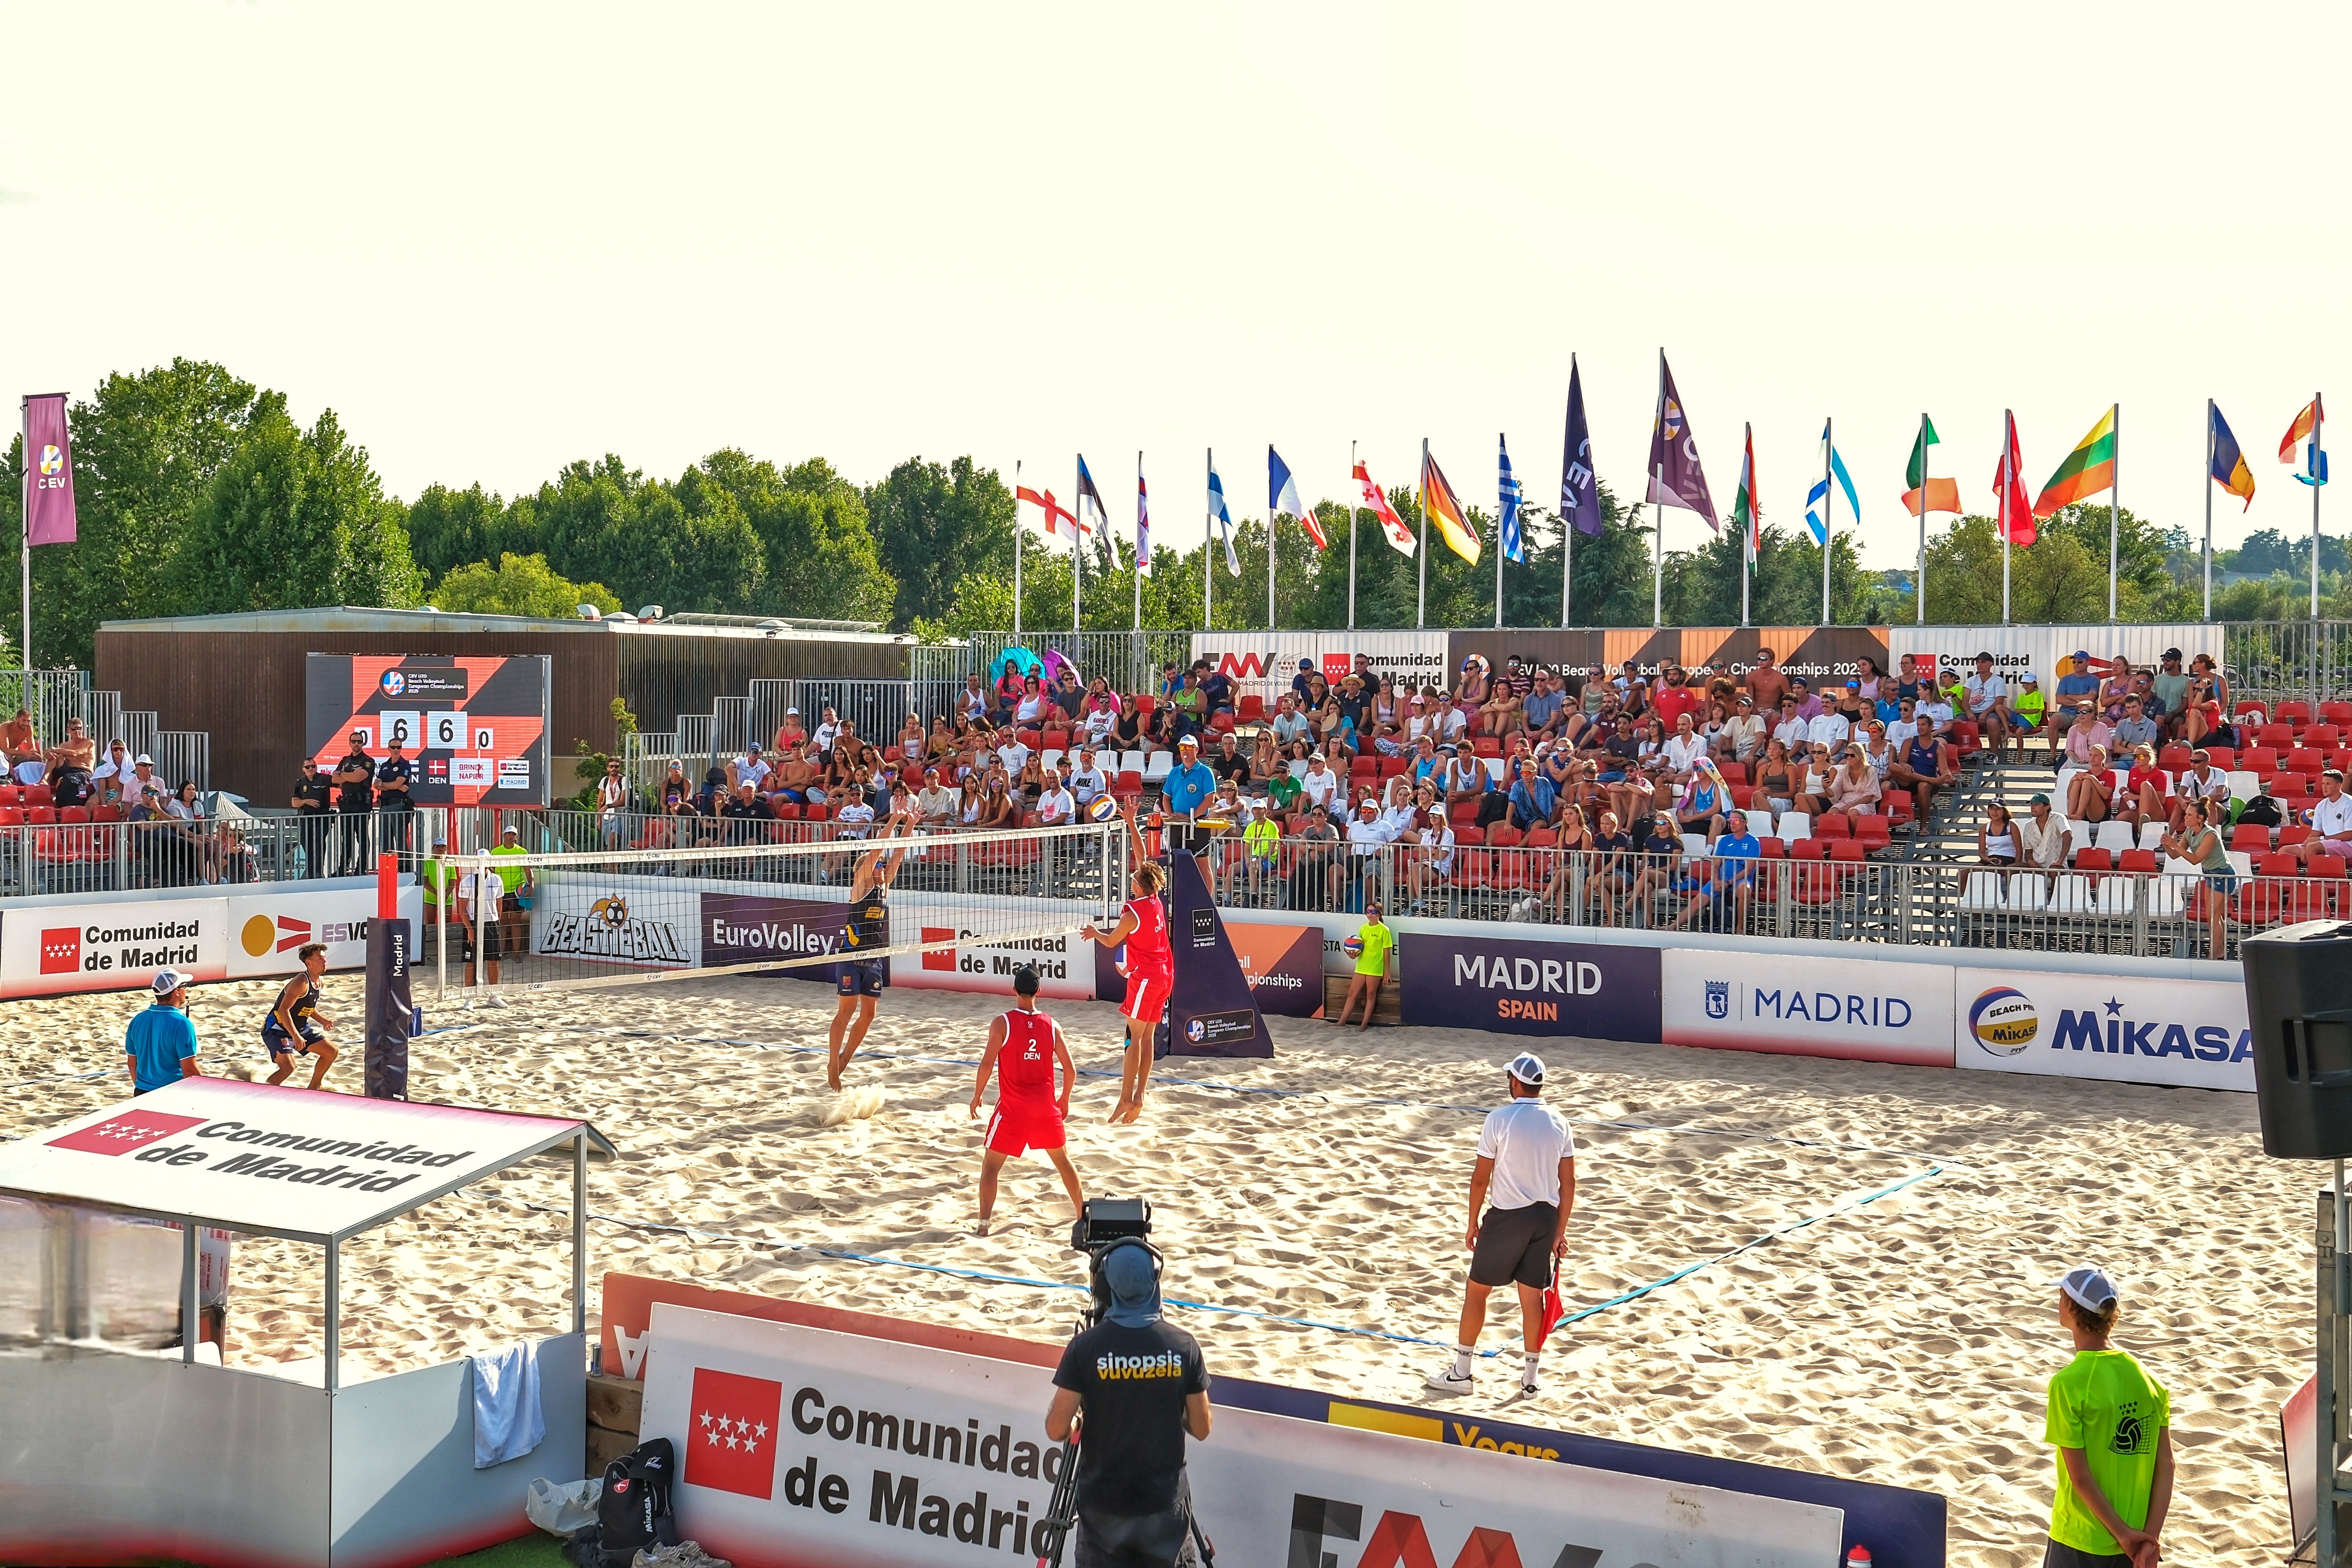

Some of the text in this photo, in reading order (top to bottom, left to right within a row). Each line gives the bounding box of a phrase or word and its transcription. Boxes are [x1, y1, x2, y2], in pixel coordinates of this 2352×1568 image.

[39, 477, 65, 489] CEV
[1365, 653, 1443, 667] omunidad
[1518, 664, 1533, 676] EV
[1562, 664, 1590, 676] Beac
[1731, 662, 1829, 678] Chaionships
[1939, 654, 2030, 666] Comidad
[393, 718, 408, 743] 6
[439, 719, 454, 743] 6
[480, 731, 490, 748] 0
[1075, 777, 1093, 787] NIKE
[1156, 914, 1161, 924] 1
[85, 920, 200, 943] Comunidad
[539, 912, 691, 963] BEASTIEBALL
[84, 945, 198, 972] de Madrid
[393, 934, 403, 977] Madrid
[960, 954, 986, 973] de
[1454, 954, 1602, 995] MADRID
[1497, 999, 1558, 1021] SPAIN
[1754, 988, 1912, 1028] MADRID
[1989, 1004, 2022, 1018] BEACH
[1993, 1023, 2038, 1041] MIKASA
[2051, 1006, 2254, 1063] MIKASA
[1023, 1052, 1041, 1060] DEN
[1028, 1039, 1037, 1051] 2
[2010, 1045, 2027, 1054] FIVB
[195, 1121, 475, 1168] Comunidad
[134, 1143, 422, 1194] de Madrid
[1097, 1349, 1182, 1372] sinopsis
[1097, 1362, 1182, 1380] vuvuzela
[784, 1455, 849, 1515] de
[644, 1496, 653, 1533] MIKASA
